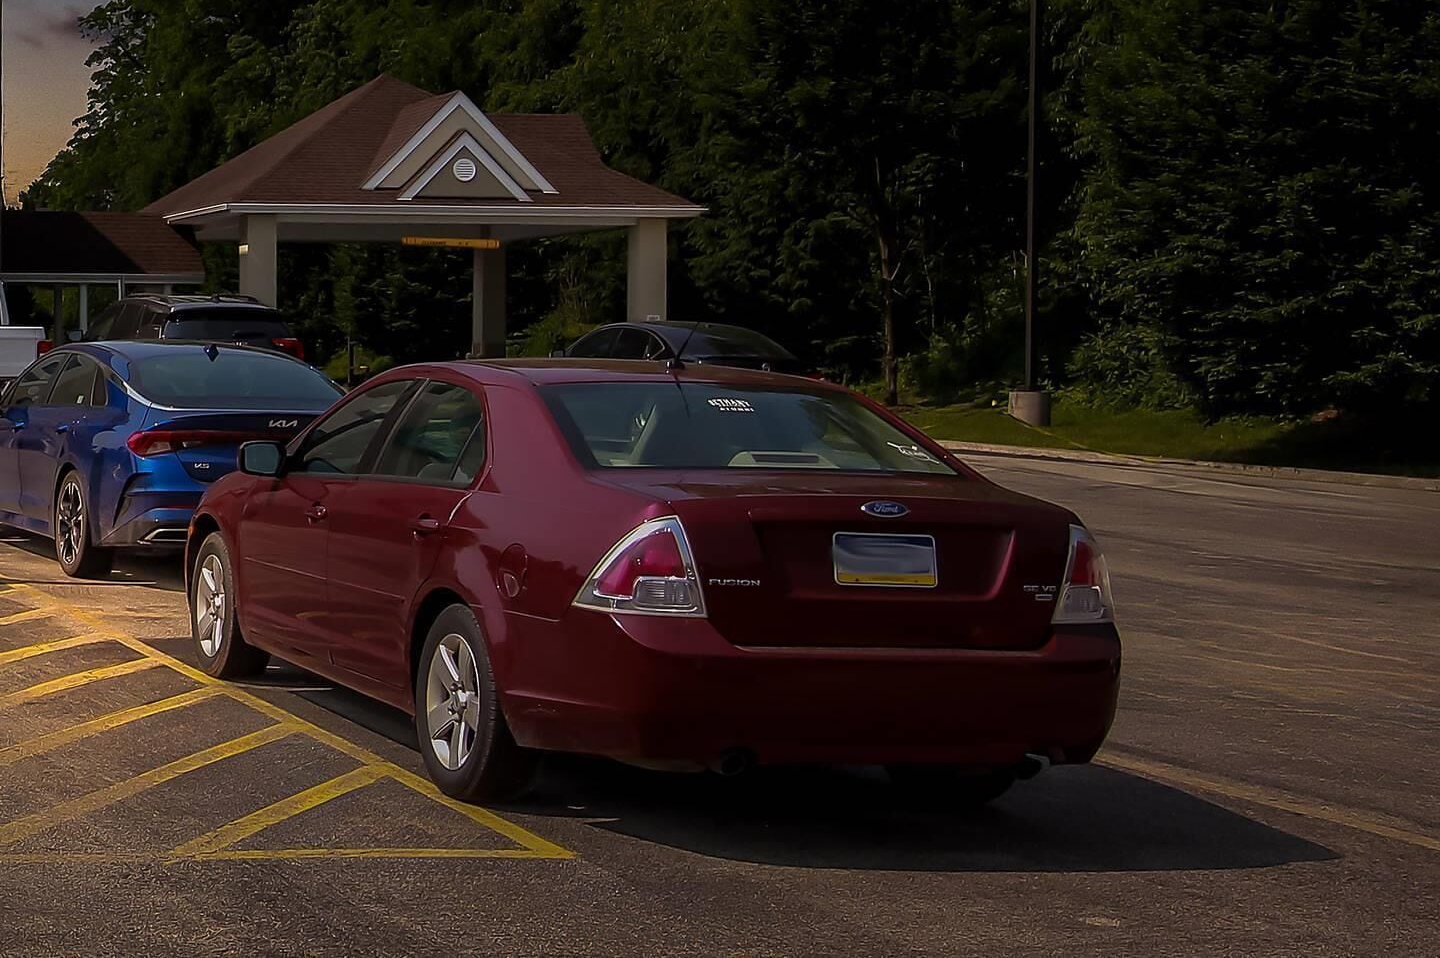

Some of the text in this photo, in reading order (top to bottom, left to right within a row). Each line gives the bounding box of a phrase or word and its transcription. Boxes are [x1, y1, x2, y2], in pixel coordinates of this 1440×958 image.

[268, 419, 298, 428] KIA
[873, 502, 899, 514] Ford
[708, 578, 761, 586] FUSION
